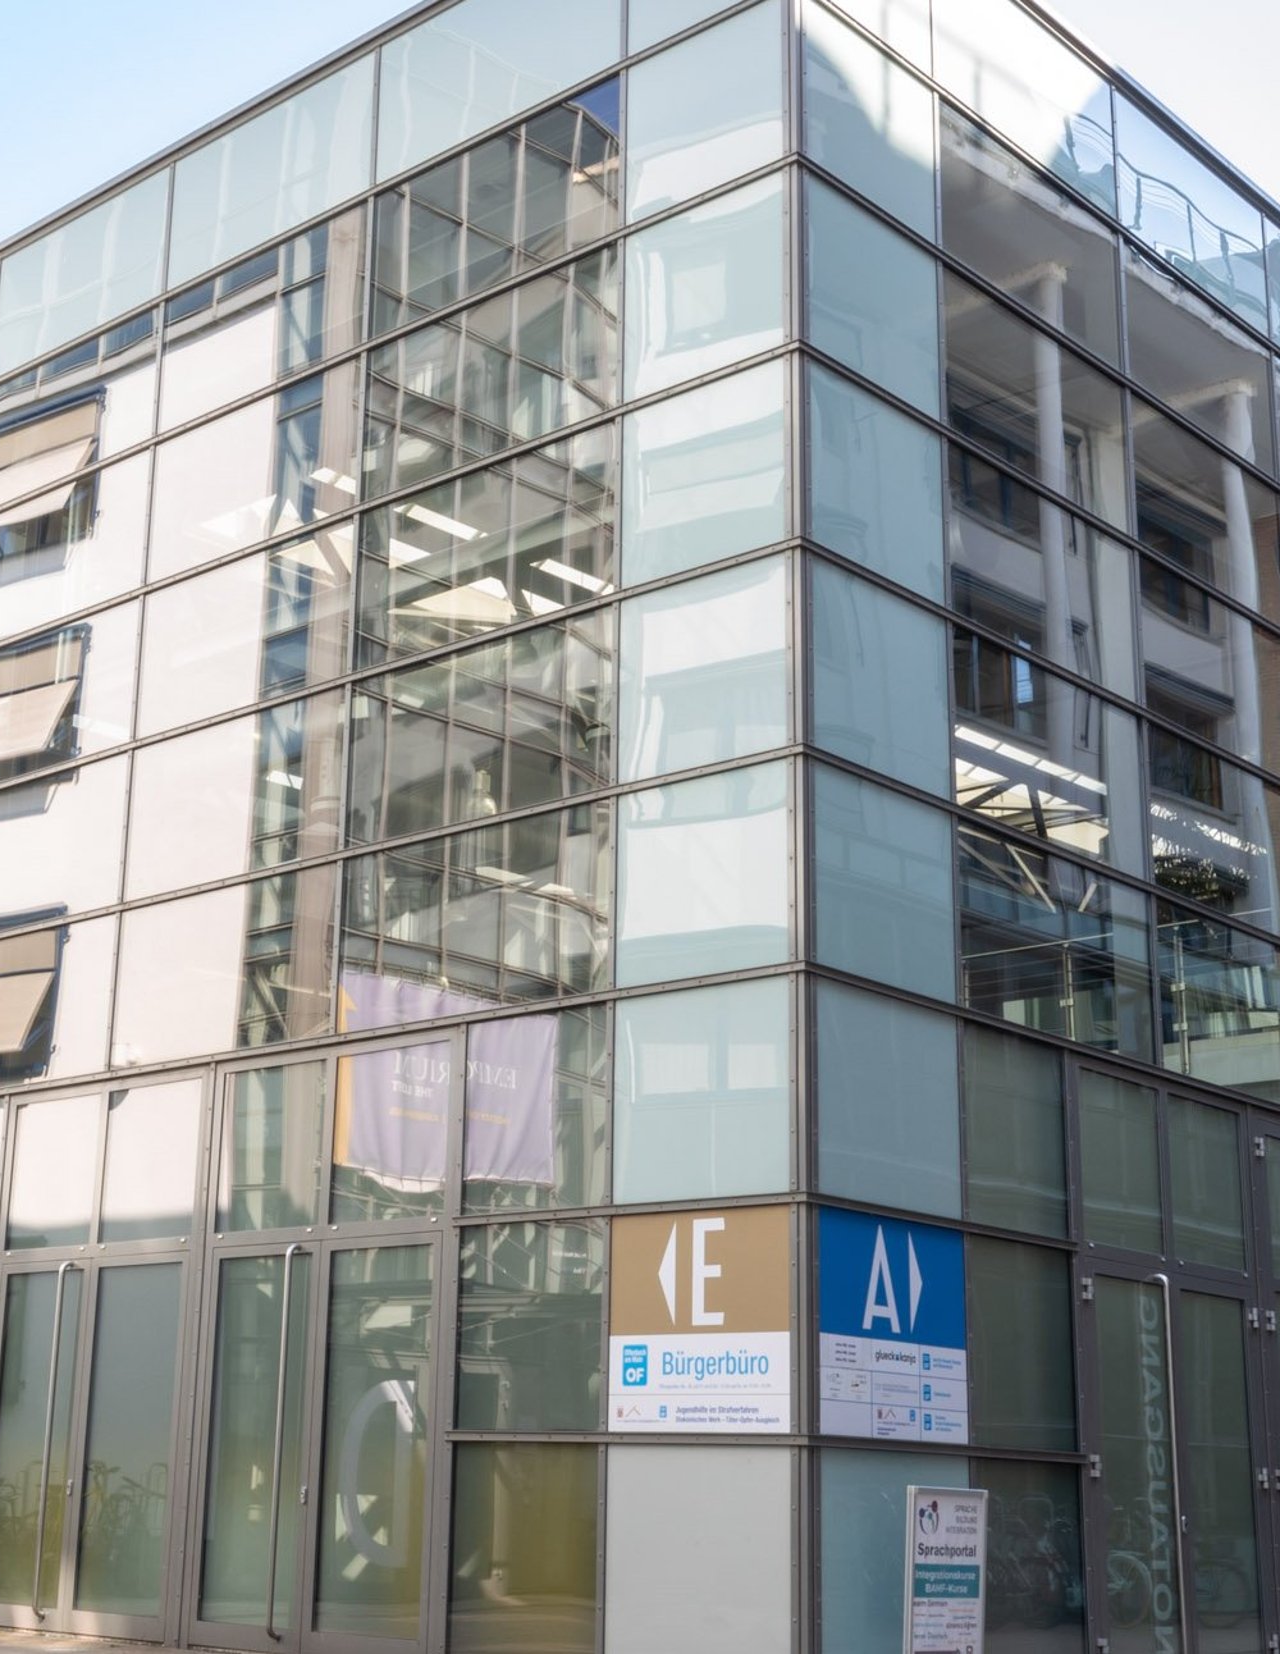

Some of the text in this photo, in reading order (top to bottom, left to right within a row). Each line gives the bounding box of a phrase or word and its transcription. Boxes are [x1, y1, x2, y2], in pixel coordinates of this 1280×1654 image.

[692, 1217, 725, 1326] E
[862, 1223, 901, 1333] A
[626, 1367, 645, 1383] OF
[662, 1350, 769, 1381] Bürgerbüro
[917, 1542, 977, 1560] Sprachportal
